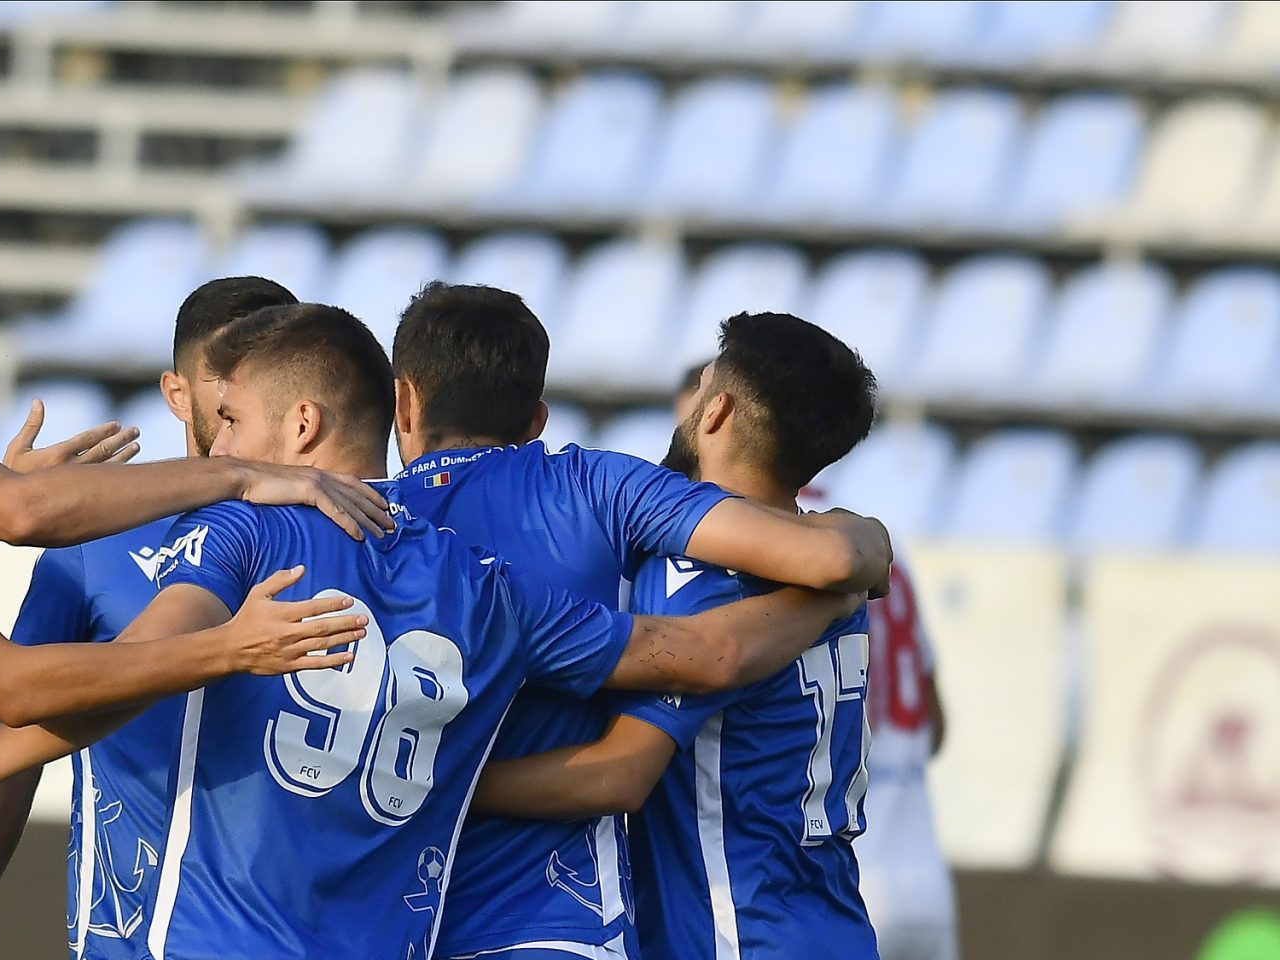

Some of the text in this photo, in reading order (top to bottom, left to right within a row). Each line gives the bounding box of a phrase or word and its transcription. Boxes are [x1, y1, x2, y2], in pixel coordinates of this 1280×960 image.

[263, 588, 470, 827] 98
[299, 765, 321, 780] FCV
[388, 796, 404, 809] FCV
[810, 819, 824, 830] FCV
